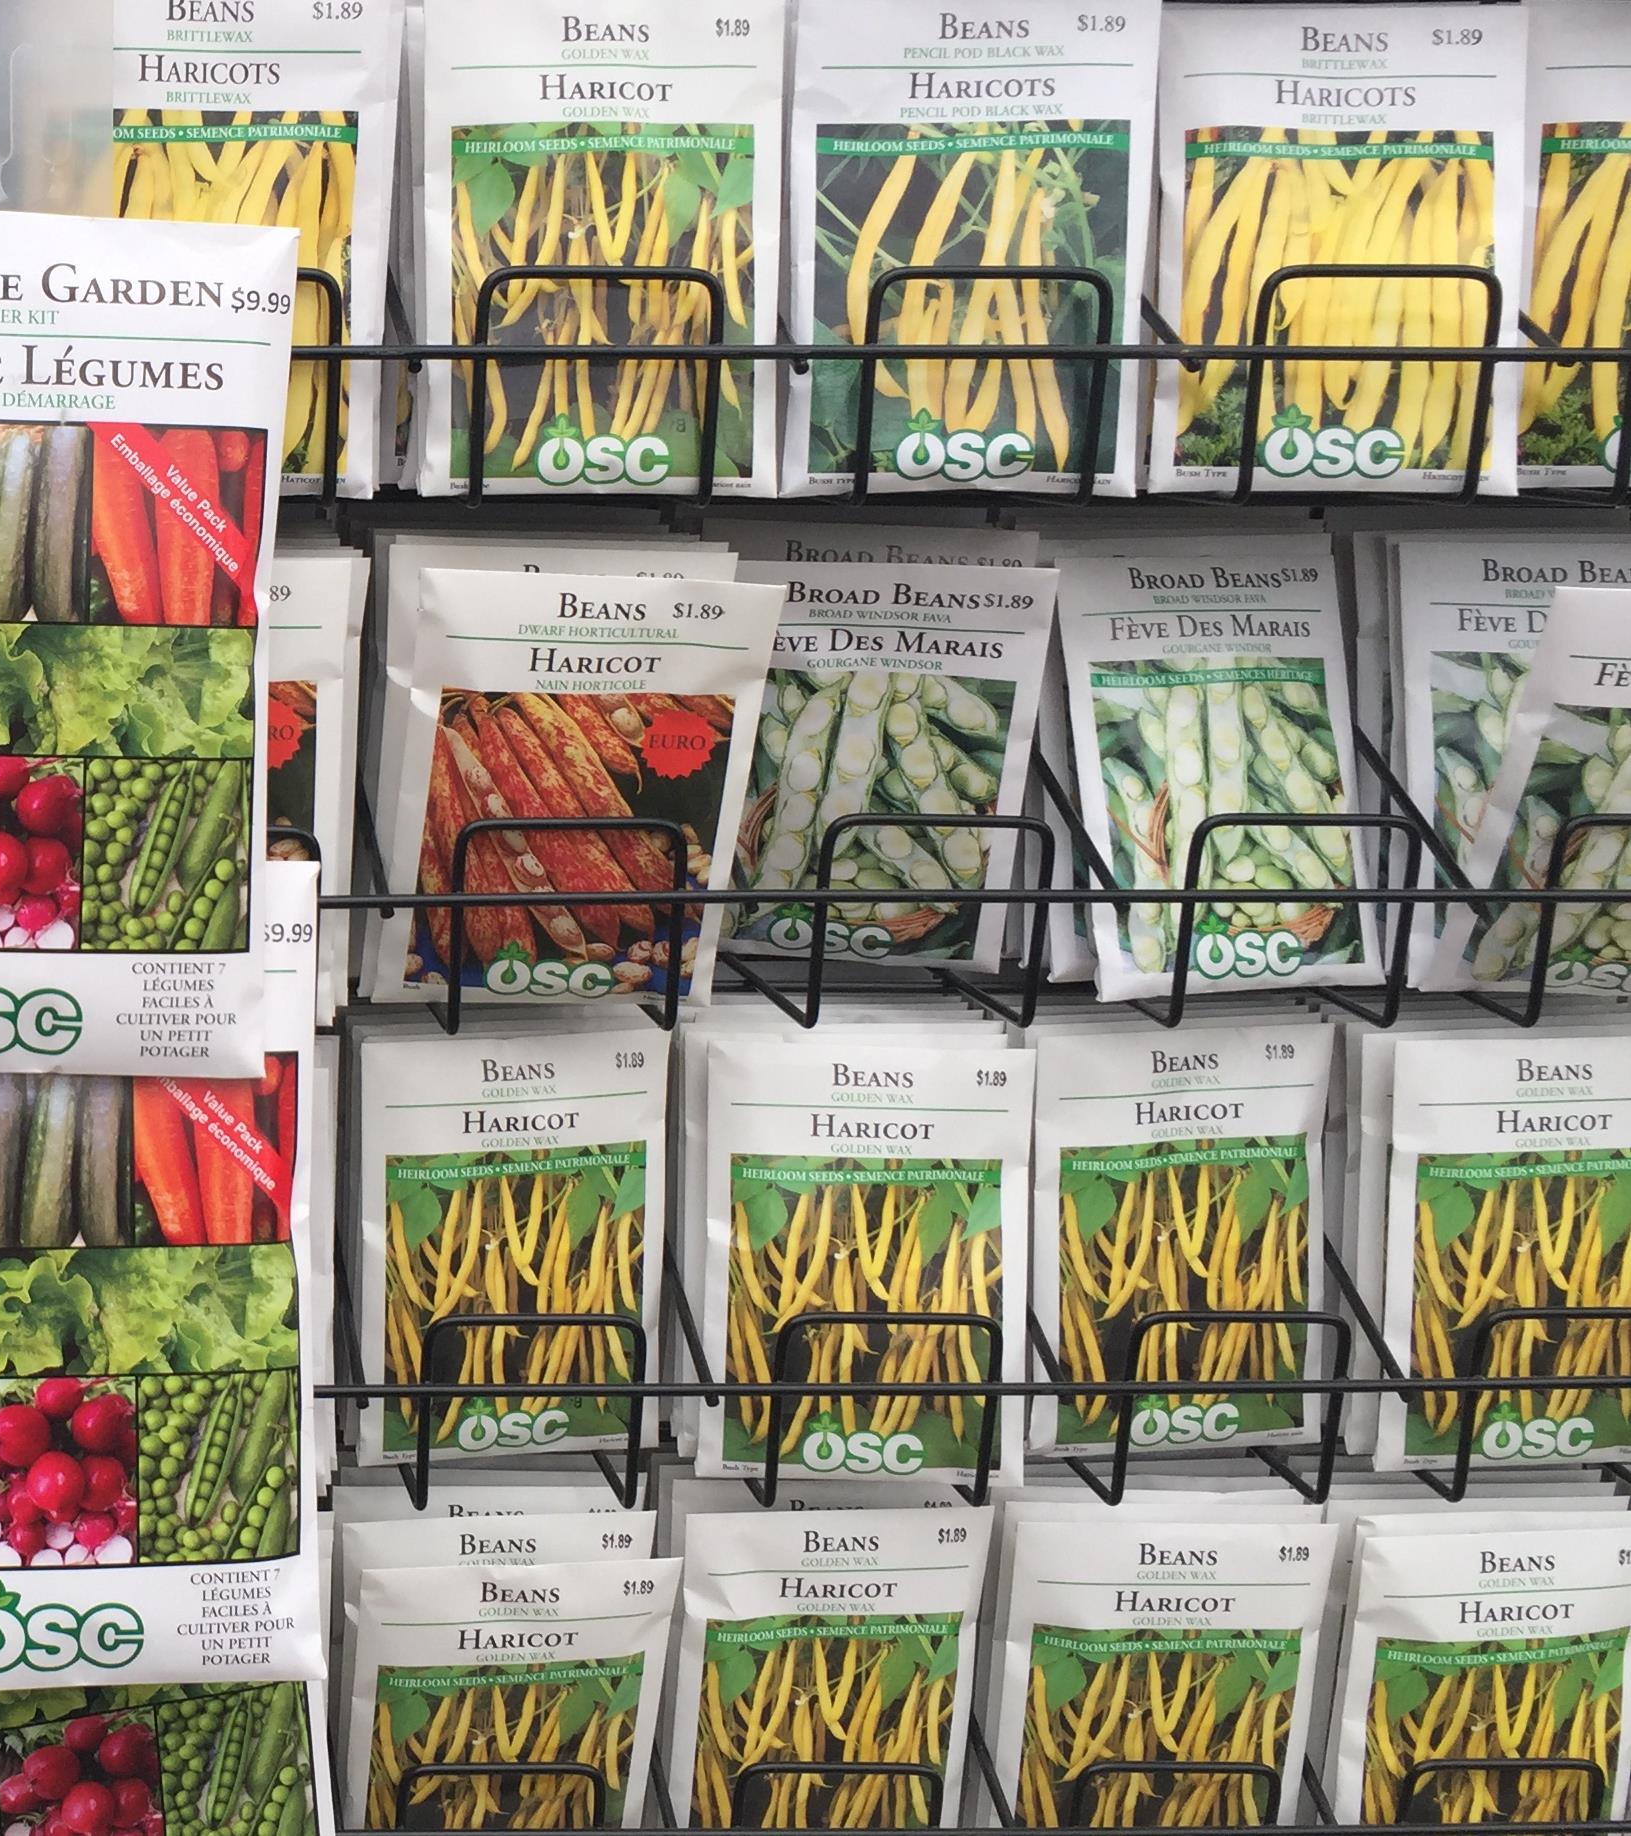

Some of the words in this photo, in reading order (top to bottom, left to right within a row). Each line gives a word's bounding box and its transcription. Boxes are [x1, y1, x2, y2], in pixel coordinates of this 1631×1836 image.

[167, 30, 255, 43] BRITTLEWAX
[561, 16, 650, 43] BEANS
[715, 18, 750, 38] $1.89
[939, 13, 1030, 40] BEANS
[1432, 29, 1483, 46] $1.89
[1301, 27, 1388, 52] BEANS
[903, 47, 950, 59] PENCIL
[954, 47, 983, 59] POD
[987, 46, 1031, 58] BLACK
[1034, 45, 1065, 57] WAX
[138, 54, 280, 85] HARICOTS
[539, 74, 673, 102] HARICOT
[908, 72, 1056, 100] HARICOTS
[1274, 80, 1416, 107] HARICOTS
[833, 140, 903, 152] HEIRLOOM
[906, 140, 945, 151] SEEDS
[955, 136, 1017, 148] SEMENCE
[1019, 134, 1115, 146] PATRIMONIALE
[41, 263, 222, 308] GARDEN
[231, 288, 291, 315] $9.99
[29, 309, 59, 325] KIT
[21, 345, 224, 390] LÉGUMES
[2, 389, 116, 409] DÉMARRAGE
[536, 433, 670, 486] OSC
[895, 429, 1036, 481] OSC
[1262, 425, 1406, 479] OSC
[110, 433, 171, 499] Emballage
[170, 498, 239, 572] économique
[166, 465, 198, 502] Value
[197, 499, 227, 533] Pack
[1128, 567, 1205, 590] BROAD
[1210, 567, 1282, 589] BEANS
[1482, 558, 1568, 584] BROAD
[786, 580, 880, 604] BROAD
[892, 582, 979, 609] BEANS
[983, 593, 1034, 609] $1.89
[558, 592, 647, 621] BEANS
[673, 602, 725, 619] $1.89
[808, 608, 853, 619] BROAD
[856, 610, 919, 622] WINDSOR
[922, 613, 952, 624] FAVA
[518, 624, 565, 636] DWARF
[568, 625, 679, 639] HORTICULTURAL
[773, 630, 818, 652] ÈVE
[829, 628, 883, 652] DES
[895, 630, 1004, 659] MARAIS
[528, 647, 662, 674] HARICOT
[806, 657, 877, 669] GOURGANE
[880, 658, 943, 671] WINDSOR
[535, 679, 570, 690] NAIN
[572, 679, 647, 691] HORTICOLE
[649, 734, 706, 750] EURO
[1195, 927, 1303, 979] OSC
[132, 962, 215, 975] CONTIENT
[218, 963, 226, 975] 7
[143, 978, 214, 992] LÉGUMES
[142, 996, 200, 1009] FACILES
[204, 993, 214, 1009] À
[115, 1012, 190, 1025] CULTIVER
[195, 1013, 236, 1026] POUR
[140, 1030, 165, 1041] UN
[169, 1030, 212, 1042] PETIT
[140, 1046, 209, 1058] POTAGER
[481, 1058, 555, 1082] BEANS
[831, 1063, 914, 1088] BEANS
[976, 1069, 1007, 1087] $1.89
[1516, 1058, 1593, 1082] BEANS
[202, 1091, 235, 1125] Value
[233, 1122, 263, 1154] Pack
[462, 1110, 580, 1134] HARICOT
[810, 1113, 935, 1140] HARICOT
[1496, 1109, 1613, 1134] HARICOT
[803, 1429, 926, 1474] OSC
[1138, 1542, 1218, 1566] BEANS
[1279, 1546, 1310, 1562] $1.89
[1480, 1551, 1555, 1574] BEANS
[202, 1586, 271, 1601] LÉGUMES
[480, 1582, 560, 1603] BEANS
[623, 1580, 654, 1596] $1.89
[1114, 1590, 1236, 1613] HARICOT
[1458, 1601, 1575, 1624] HARICOT
[458, 1629, 579, 1650] HARICOT
[202, 1653, 271, 1665] POTAGER
